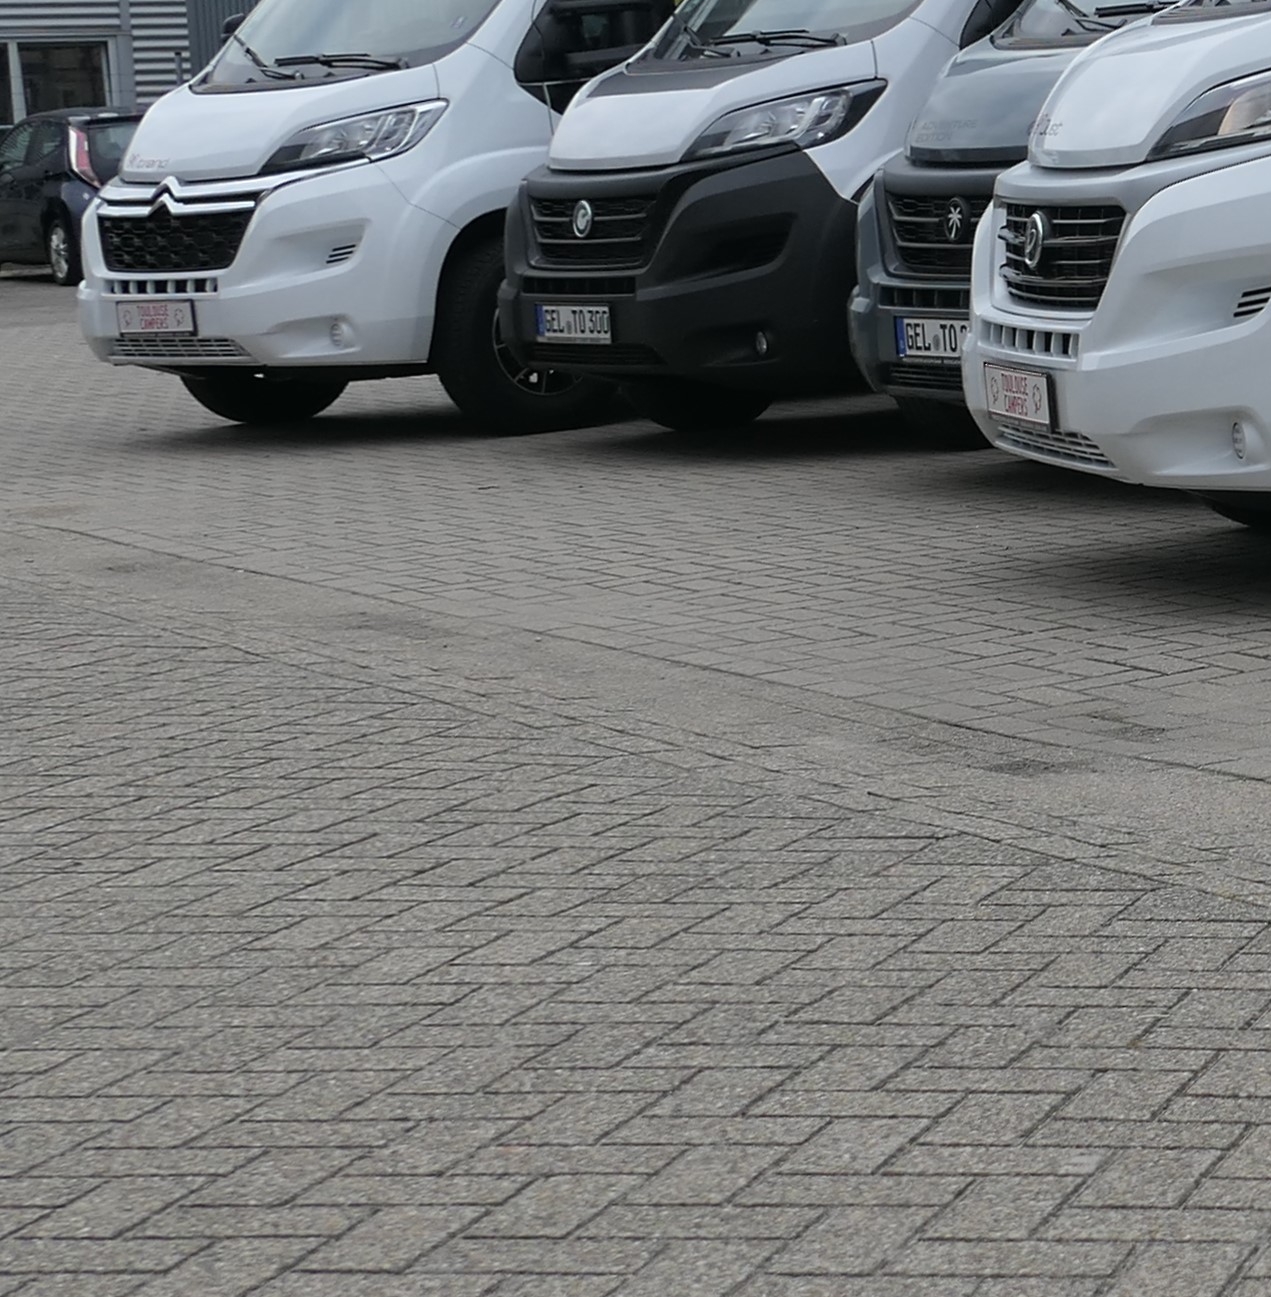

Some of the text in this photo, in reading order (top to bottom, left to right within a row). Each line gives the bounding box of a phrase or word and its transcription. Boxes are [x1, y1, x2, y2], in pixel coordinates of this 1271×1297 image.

[544, 309, 564, 333] GEL
[587, 309, 610, 334] 300
[905, 322, 958, 352] GEL TO
